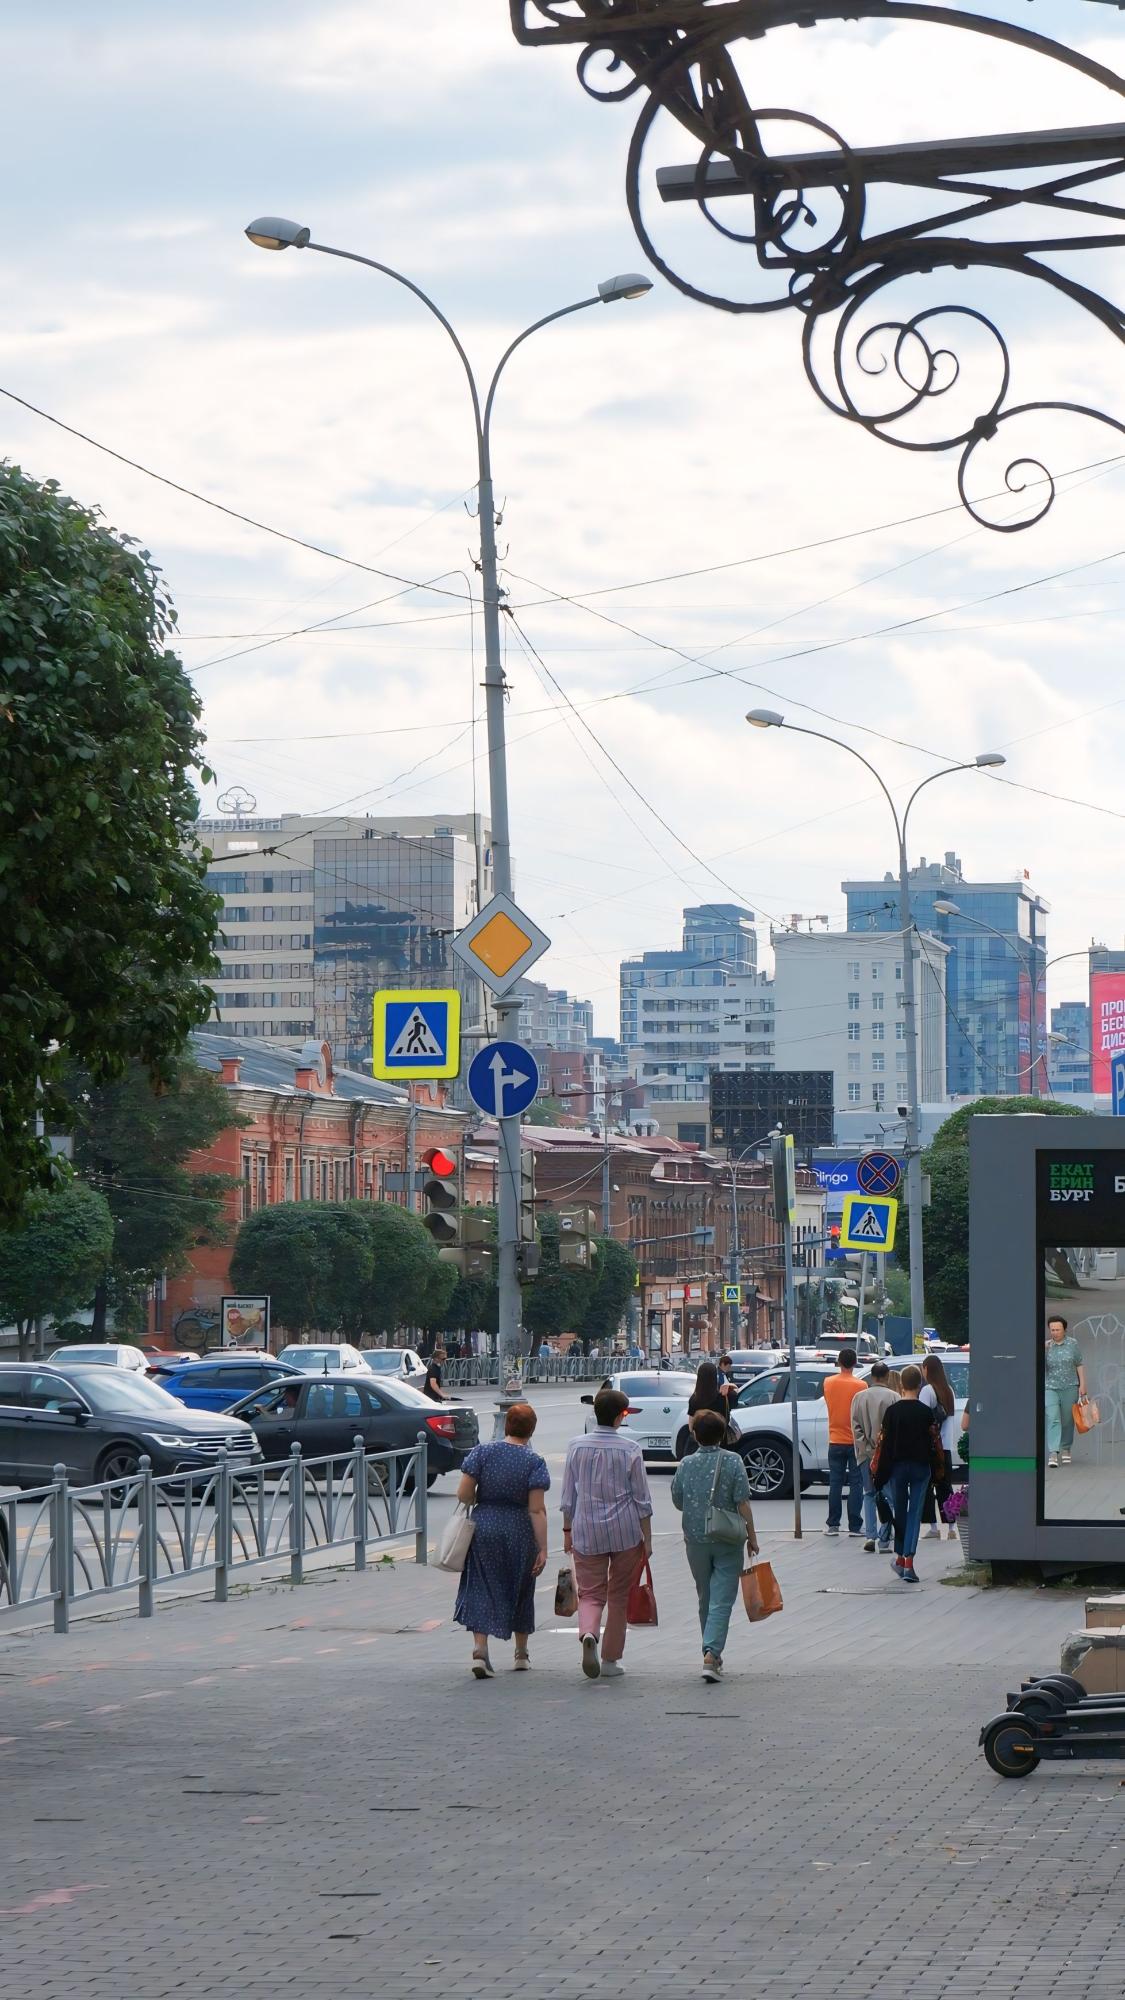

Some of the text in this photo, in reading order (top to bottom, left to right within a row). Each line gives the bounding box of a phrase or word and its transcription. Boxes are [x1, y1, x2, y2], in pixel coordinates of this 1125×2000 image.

[1101, 999, 1125, 1017] ПРО
[1049, 1164, 1094, 1176] ЕКАТ
[1049, 1176, 1094, 1189] ЕРИН
[1049, 1189, 1094, 1201] БУРГ
